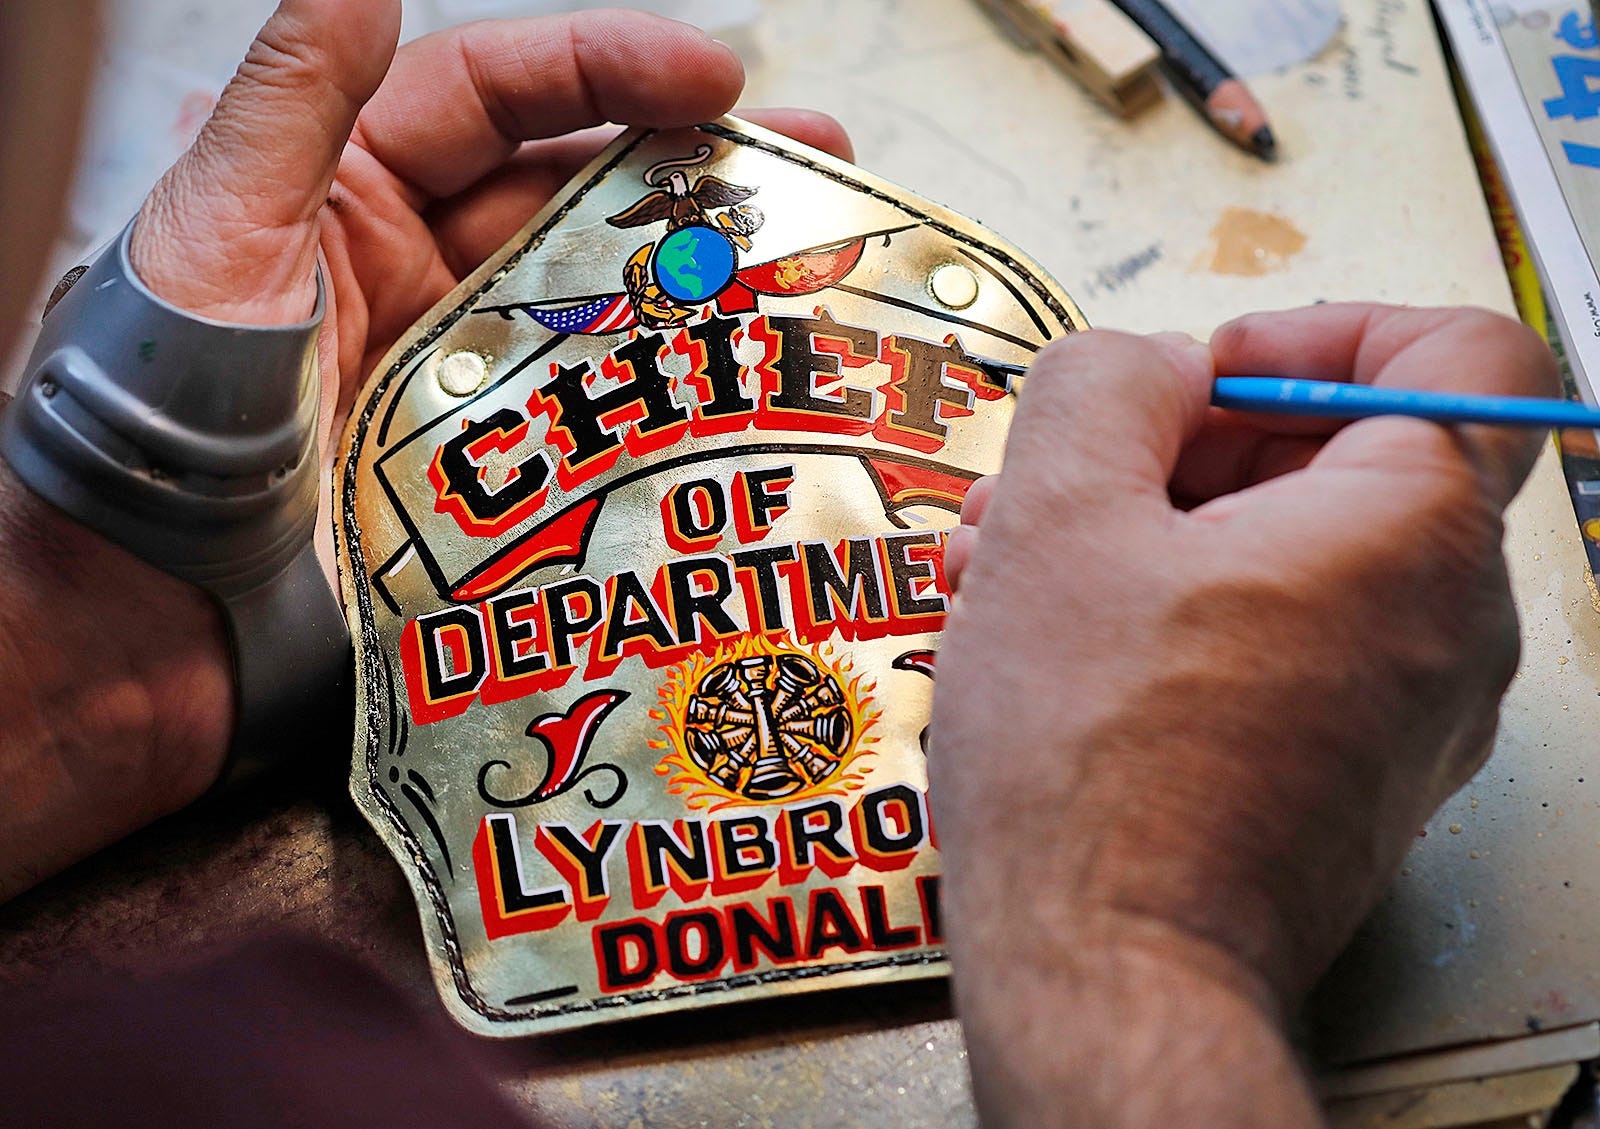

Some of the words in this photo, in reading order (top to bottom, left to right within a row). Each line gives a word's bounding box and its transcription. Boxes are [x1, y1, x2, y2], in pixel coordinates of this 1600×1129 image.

[427, 304, 1012, 538] CHIEF
[661, 463, 796, 555] OF
[401, 530, 952, 721] DEPARTME
[473, 782, 939, 940] LYNBRO
